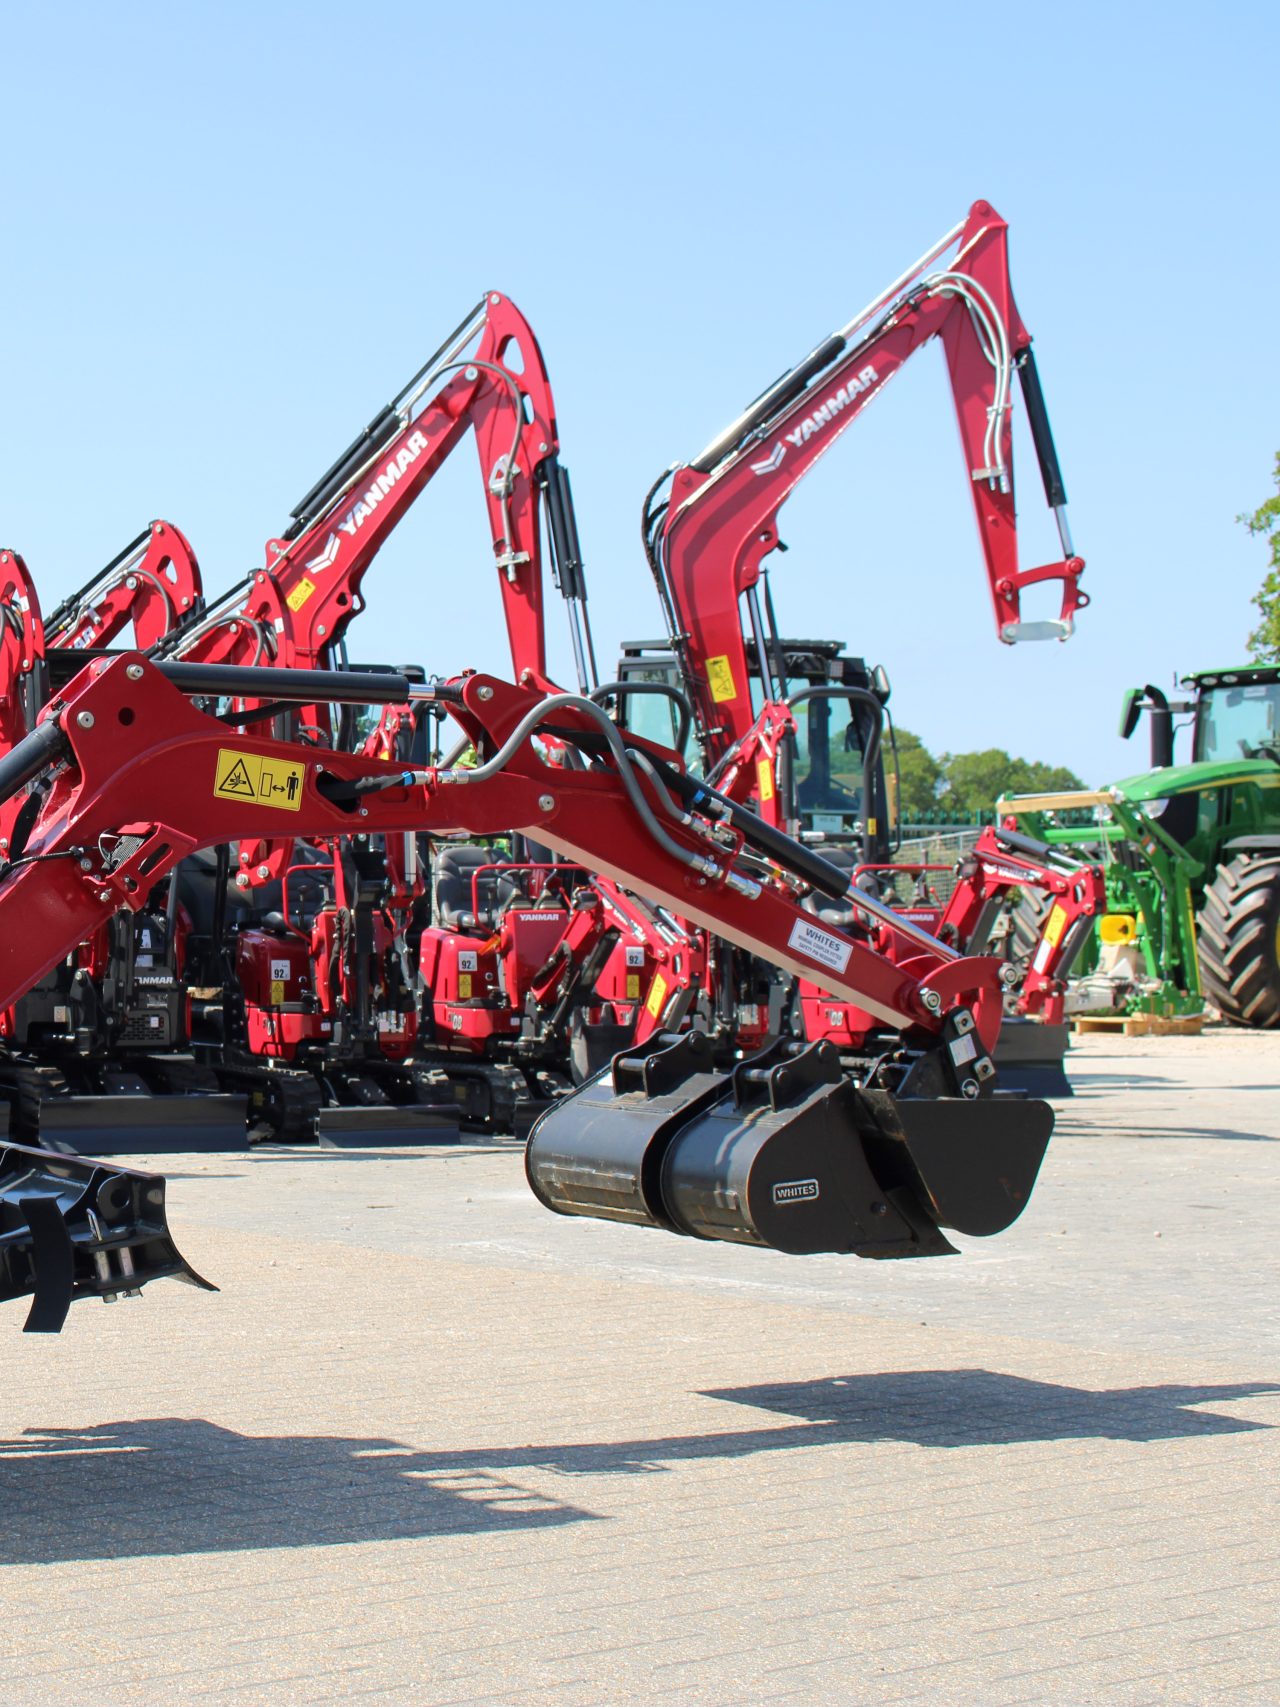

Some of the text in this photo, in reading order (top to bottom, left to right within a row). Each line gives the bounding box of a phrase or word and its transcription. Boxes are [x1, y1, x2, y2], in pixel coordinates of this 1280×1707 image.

[785, 365, 878, 447] YANMAR
[338, 430, 428, 535] YANMAR
[806, 928, 840, 951] WHITES
[461, 960, 472, 970] 92
[629, 955, 639, 964] 92
[274, 969, 284, 978] 92
[777, 1185, 815, 1199] WHITES
